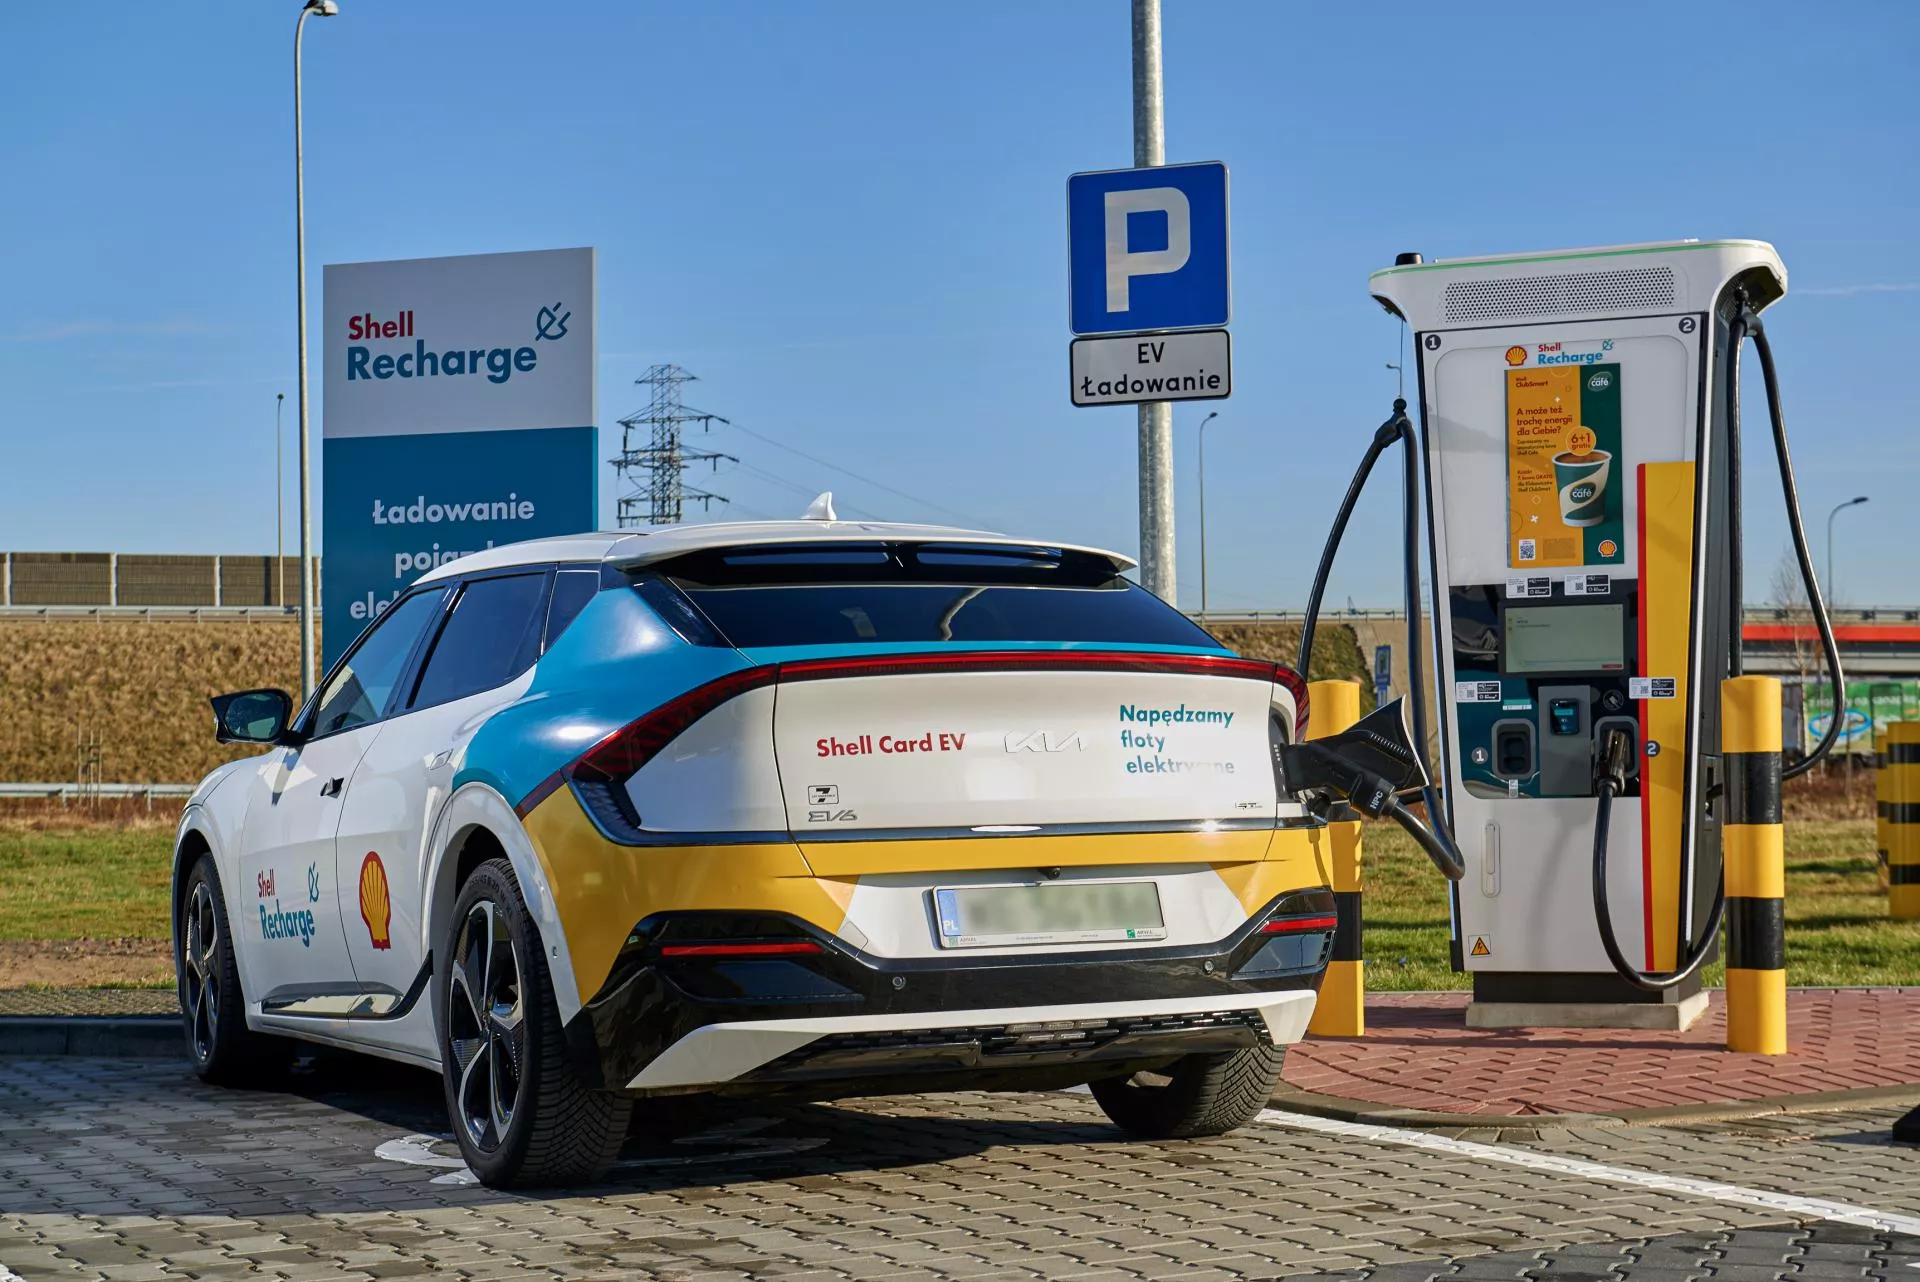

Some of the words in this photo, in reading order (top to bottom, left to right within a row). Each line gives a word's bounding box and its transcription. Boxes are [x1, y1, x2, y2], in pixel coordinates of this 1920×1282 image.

[1104, 186, 1191, 313] P
[348, 310, 414, 341] Shell
[1682, 319, 1692, 332] 2
[1137, 342, 1165, 364] EV
[1429, 336, 1438, 349] 1
[1537, 341, 1561, 353] Shell
[347, 339, 537, 384] Recharge
[1537, 351, 1604, 365] Recharge
[1081, 369, 1221, 397] Ładowanie
[372, 493, 535, 525] Ładowanie
[1119, 703, 1235, 729] Napędzamy
[816, 735, 872, 757] Shell
[878, 733, 933, 755] Card
[938, 733, 966, 752] EV
[1121, 729, 1166, 753] floty
[1647, 742, 1657, 755] 2
[1475, 749, 1485, 762] 1
[1369, 790, 1384, 809] HPC
[808, 809, 858, 823] EV6
[257, 868, 276, 898] Shell
[258, 898, 316, 948] Recharge
[942, 919, 958, 931] PL
